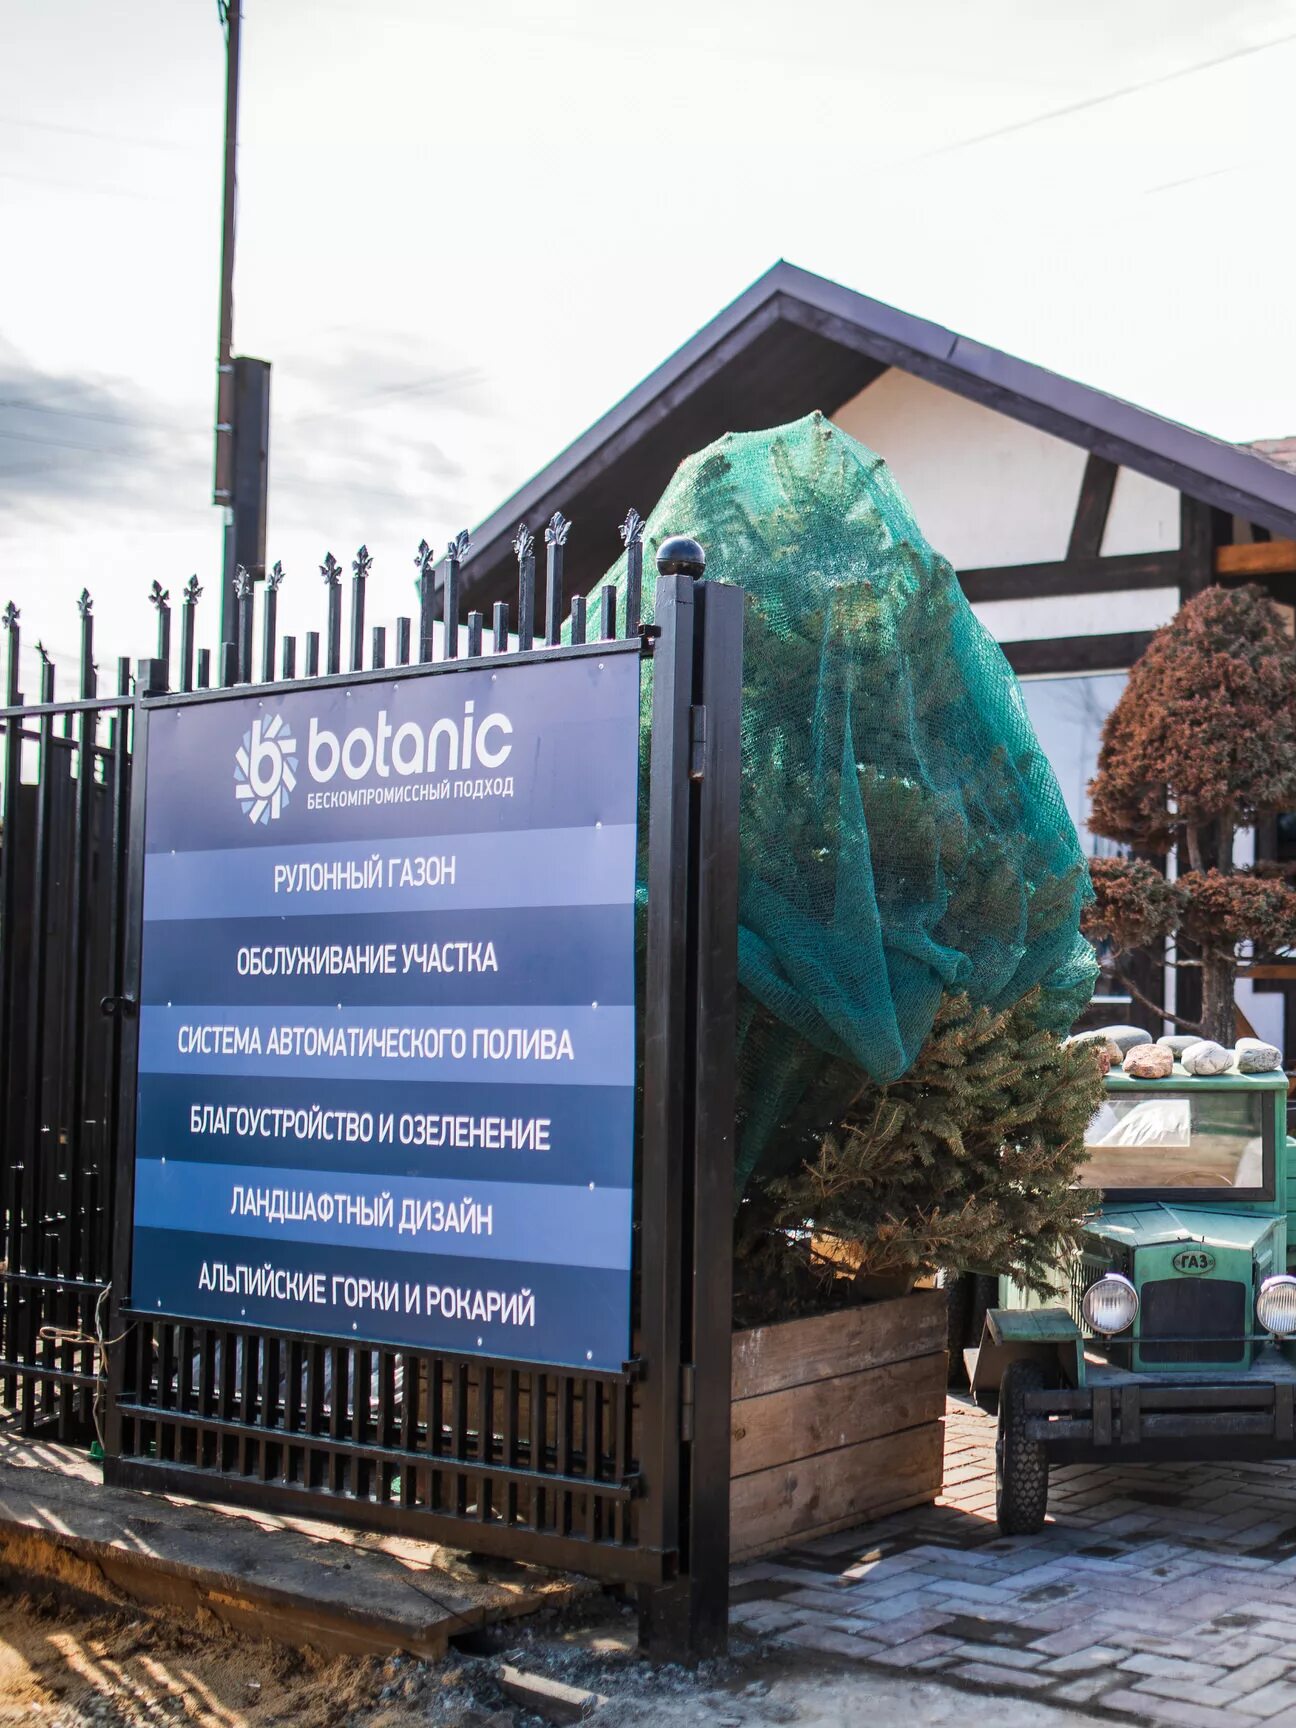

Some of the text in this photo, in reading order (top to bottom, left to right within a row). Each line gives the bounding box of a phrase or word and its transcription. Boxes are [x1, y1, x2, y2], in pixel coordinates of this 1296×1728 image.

[307, 700, 514, 784] botanic
[306, 776, 515, 810] БЕСКОМПРОМИССНЫЙ ПОДХОД
[274, 854, 457, 893] РУЛОННЫЙ ГАЗОН
[236, 942, 499, 976] ОБСЛУЖИВАНИЕ УЧАСТКА
[177, 1026, 575, 1061] СИСТЕМА АВТОМАТИЧЕСКОГО ПОЛИВА
[189, 1105, 551, 1151] БЛАГОУСТРОЙСТВО И ОЗЕЛЕНЕНИЕ
[230, 1186, 493, 1235] ЛАНДШАФТНЫЙ ДИЗАЙН
[1181, 1255, 1208, 1269] ГАЗ
[198, 1262, 536, 1327] АЛЬПИЙСКИЕ ГОРКИ И РОКАРИЙ
